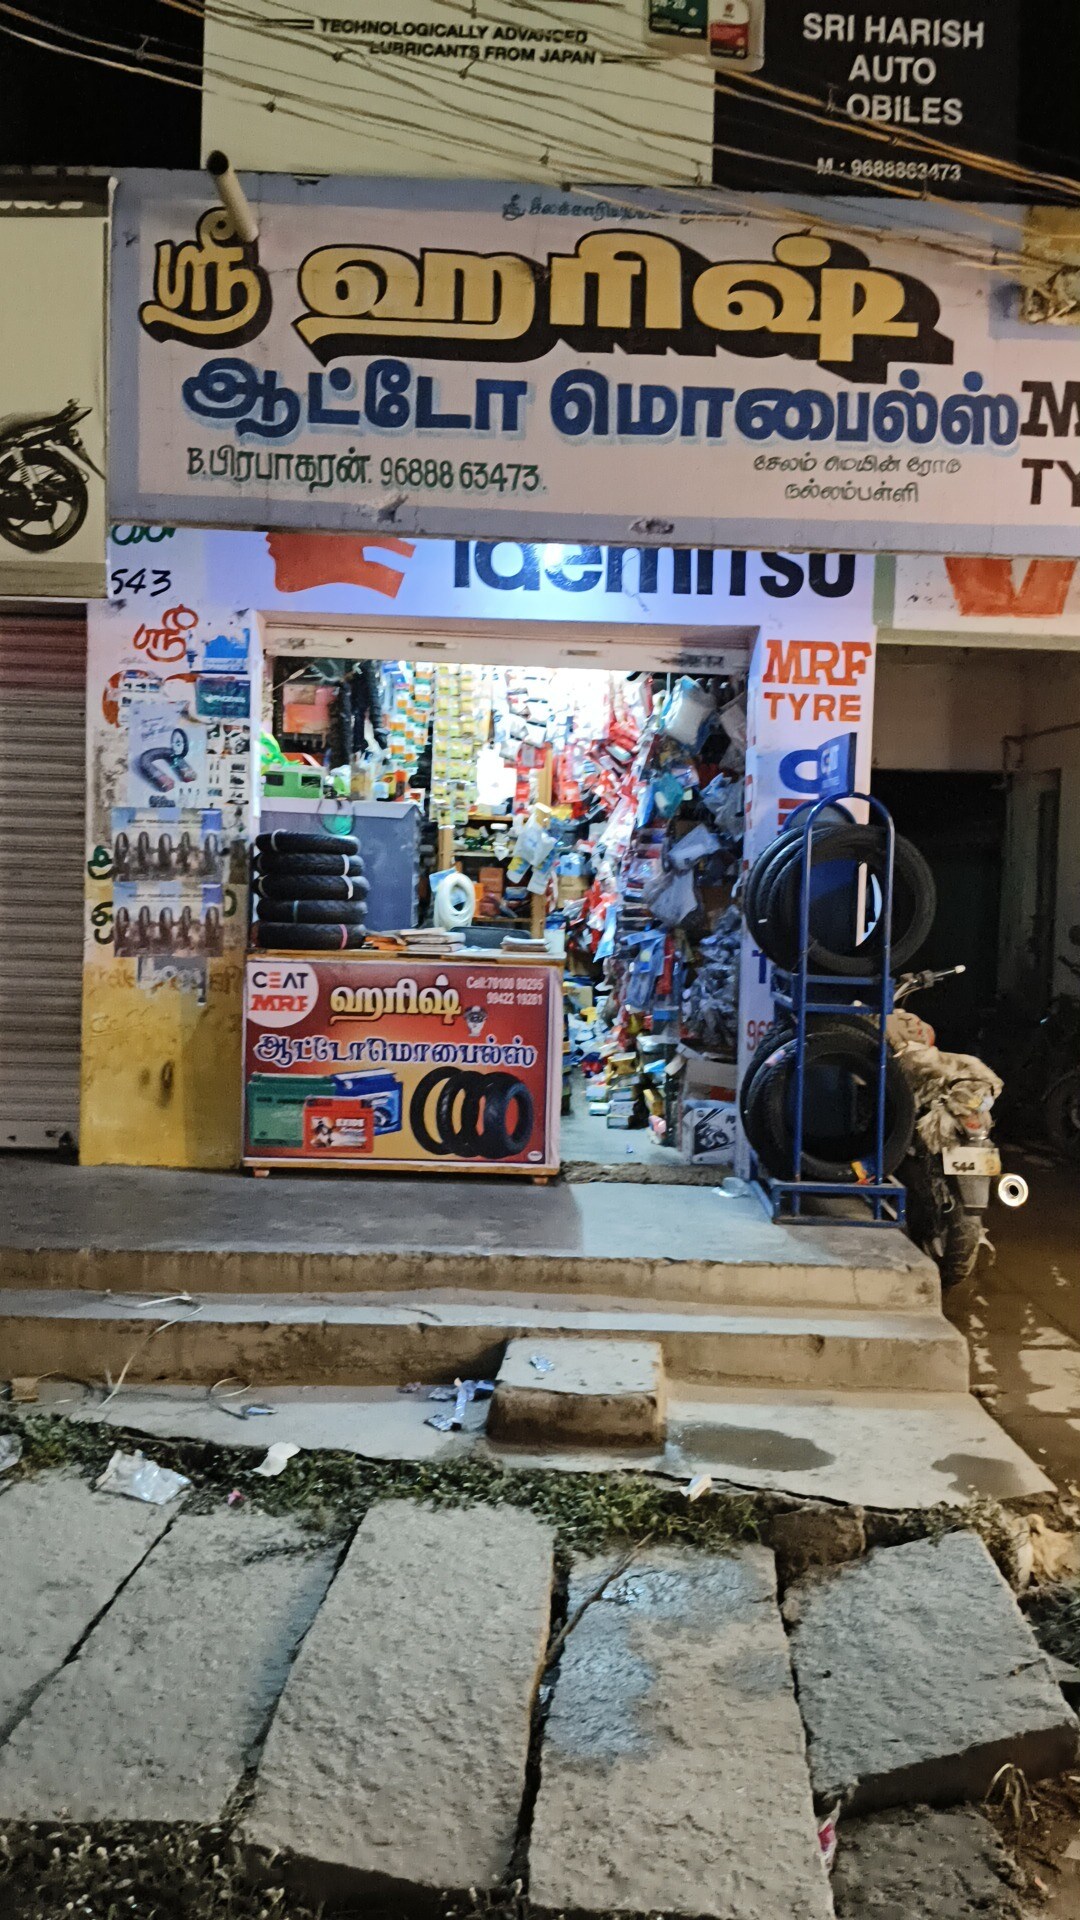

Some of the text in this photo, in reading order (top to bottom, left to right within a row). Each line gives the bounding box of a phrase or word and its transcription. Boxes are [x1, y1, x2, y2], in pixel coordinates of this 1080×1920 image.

[319, 17, 488, 40] TECHNOLOGICALLY
[802, 11, 985, 50] SRI HARISH
[484, 45, 536, 62] FROM
[539, 48, 596, 65] JAPAN
[848, 55, 936, 86] AUTO
[293, 229, 948, 380] ஹரிஷ்
[380, 457, 454, 489] 96888
[762, 639, 872, 687] MRF
[763, 692, 862, 722] TYRE
[252, 971, 309, 989] CEAT
[330, 973, 462, 1025] ஹரிஷ்
